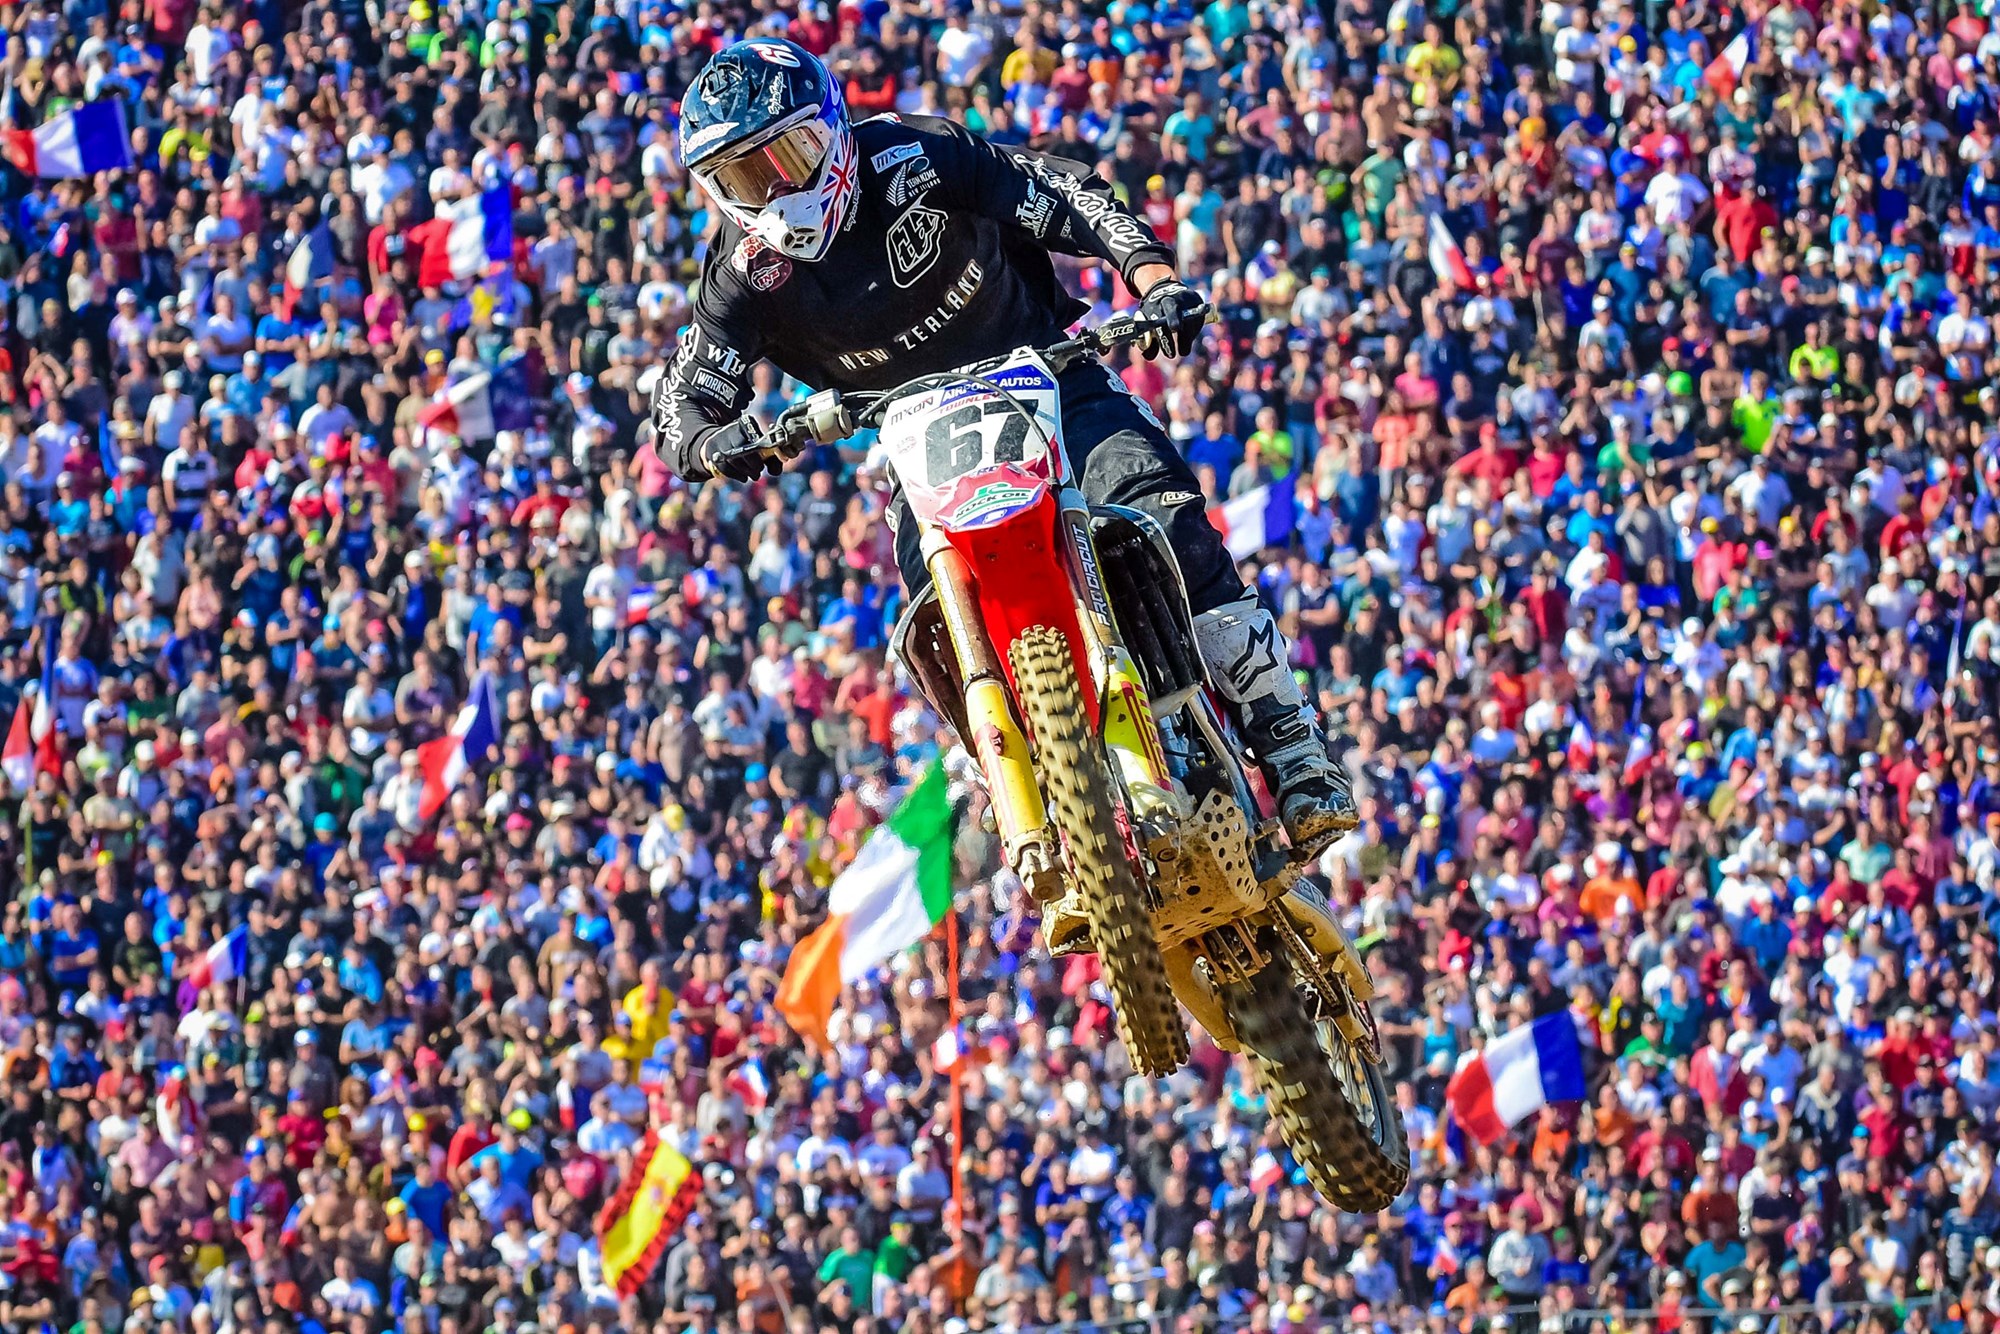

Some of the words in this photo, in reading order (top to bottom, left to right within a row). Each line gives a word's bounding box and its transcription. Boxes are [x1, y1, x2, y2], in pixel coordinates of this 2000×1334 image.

[838, 348, 888, 371] NEW
[898, 261, 984, 351] ZEALAND
[1100, 324, 1135, 341] ARC
[999, 377, 1042, 387] AUTOS
[925, 399, 1039, 487] 67
[1075, 524, 1102, 594] CIRCUIT
[1090, 589, 1112, 627] PRO
